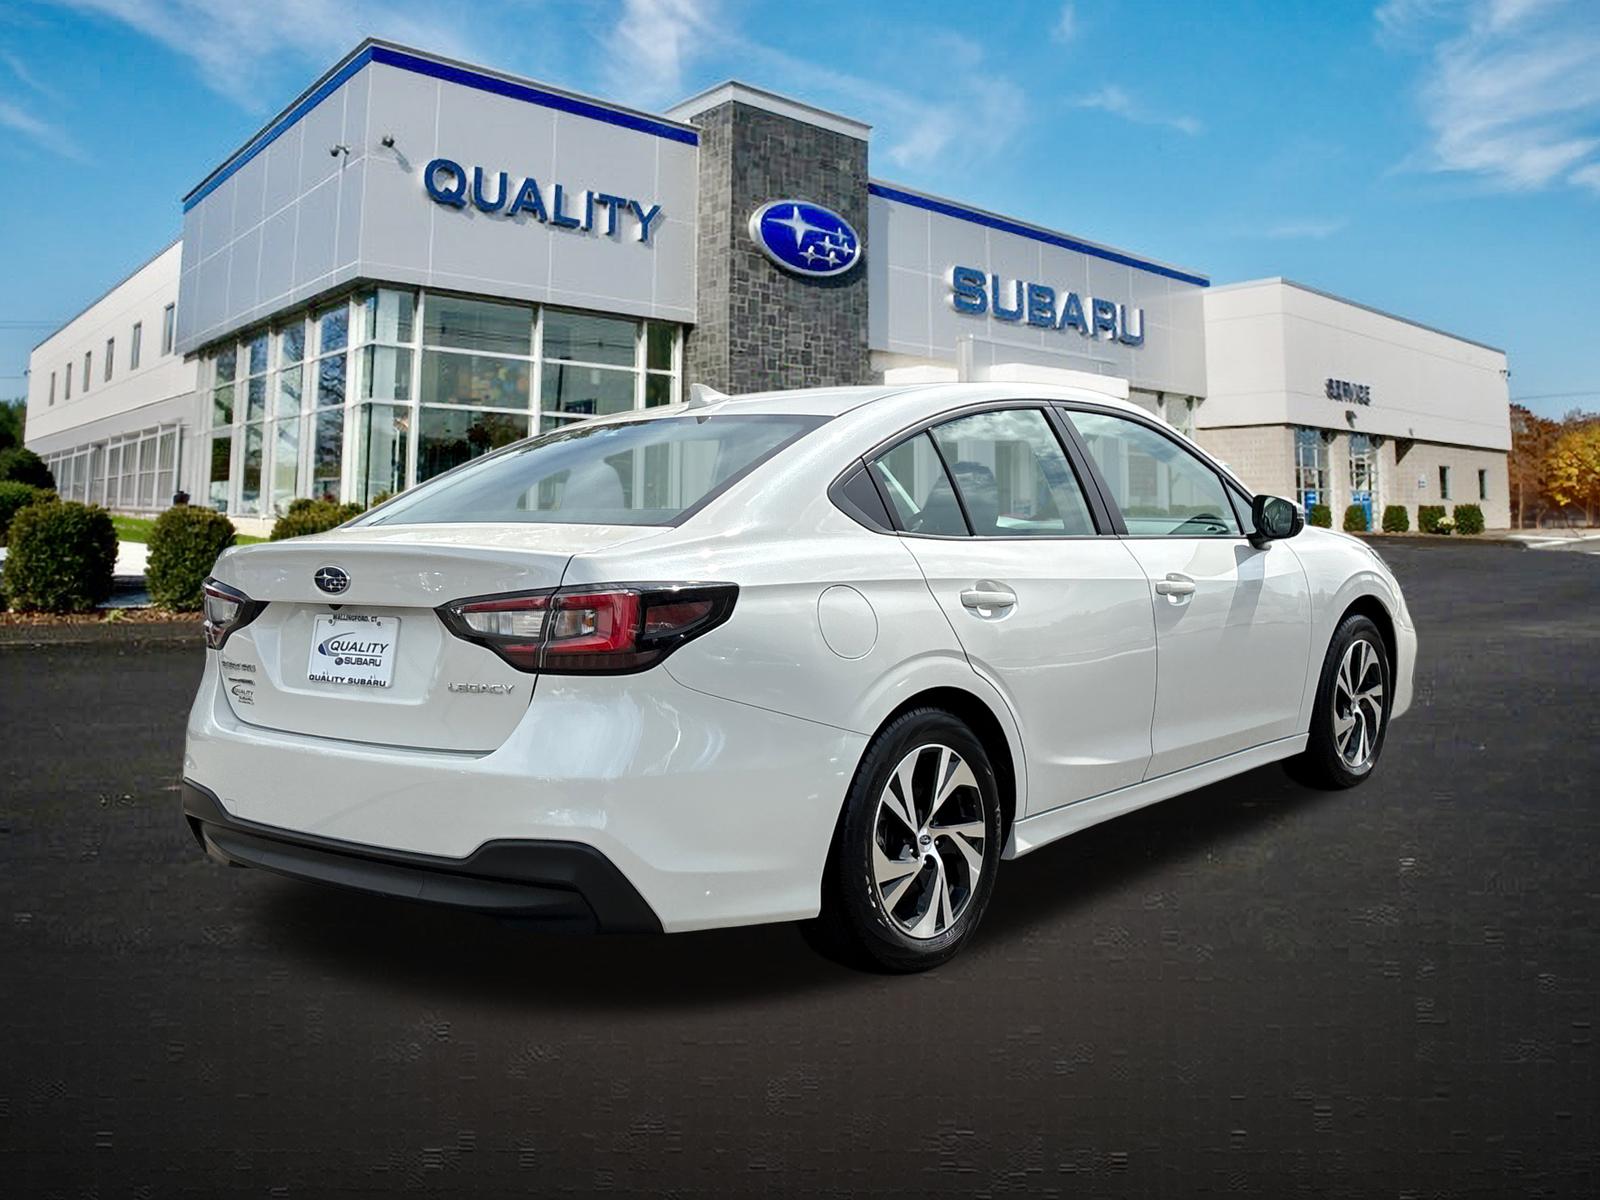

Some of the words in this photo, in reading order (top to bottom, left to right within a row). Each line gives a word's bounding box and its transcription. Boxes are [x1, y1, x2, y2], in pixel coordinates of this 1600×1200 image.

[424, 158, 661, 242] QUALITY
[945, 265, 1144, 346] SUBARU
[330, 641, 389, 653] QUALITY
[344, 657, 381, 667] SUBARU
[308, 674, 346, 683] QUALITY
[347, 678, 386, 687] SUBARU
[448, 682, 515, 694] LEGACY
